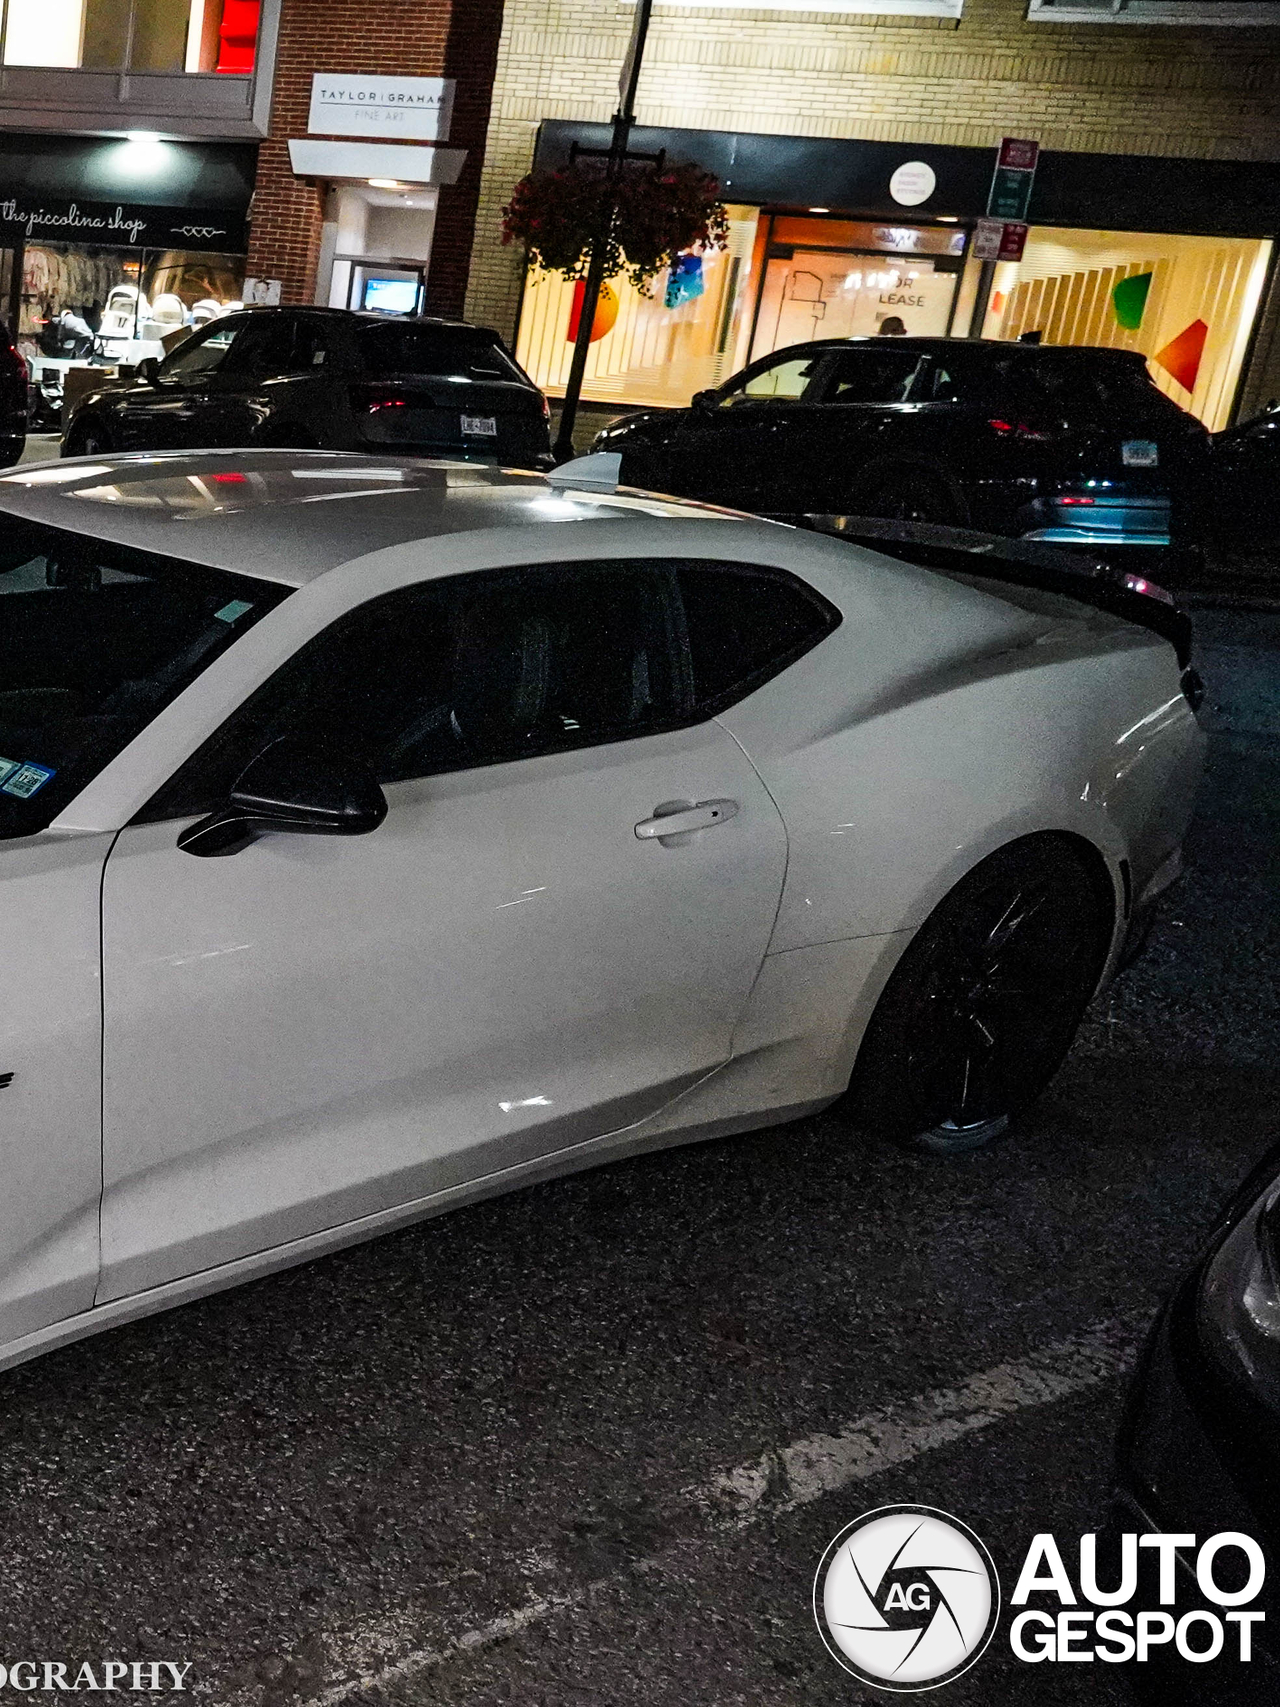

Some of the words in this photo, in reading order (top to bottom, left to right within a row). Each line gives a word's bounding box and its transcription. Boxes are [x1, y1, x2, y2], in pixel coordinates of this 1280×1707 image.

[321, 89, 377, 101] TAYLOR
[354, 111, 380, 121] FINE
[385, 112, 405, 121] ART
[0, 199, 28, 222] the
[25, 203, 106, 237] piccolina
[107, 206, 147, 243] shop
[878, 293, 926, 307] LEASE
